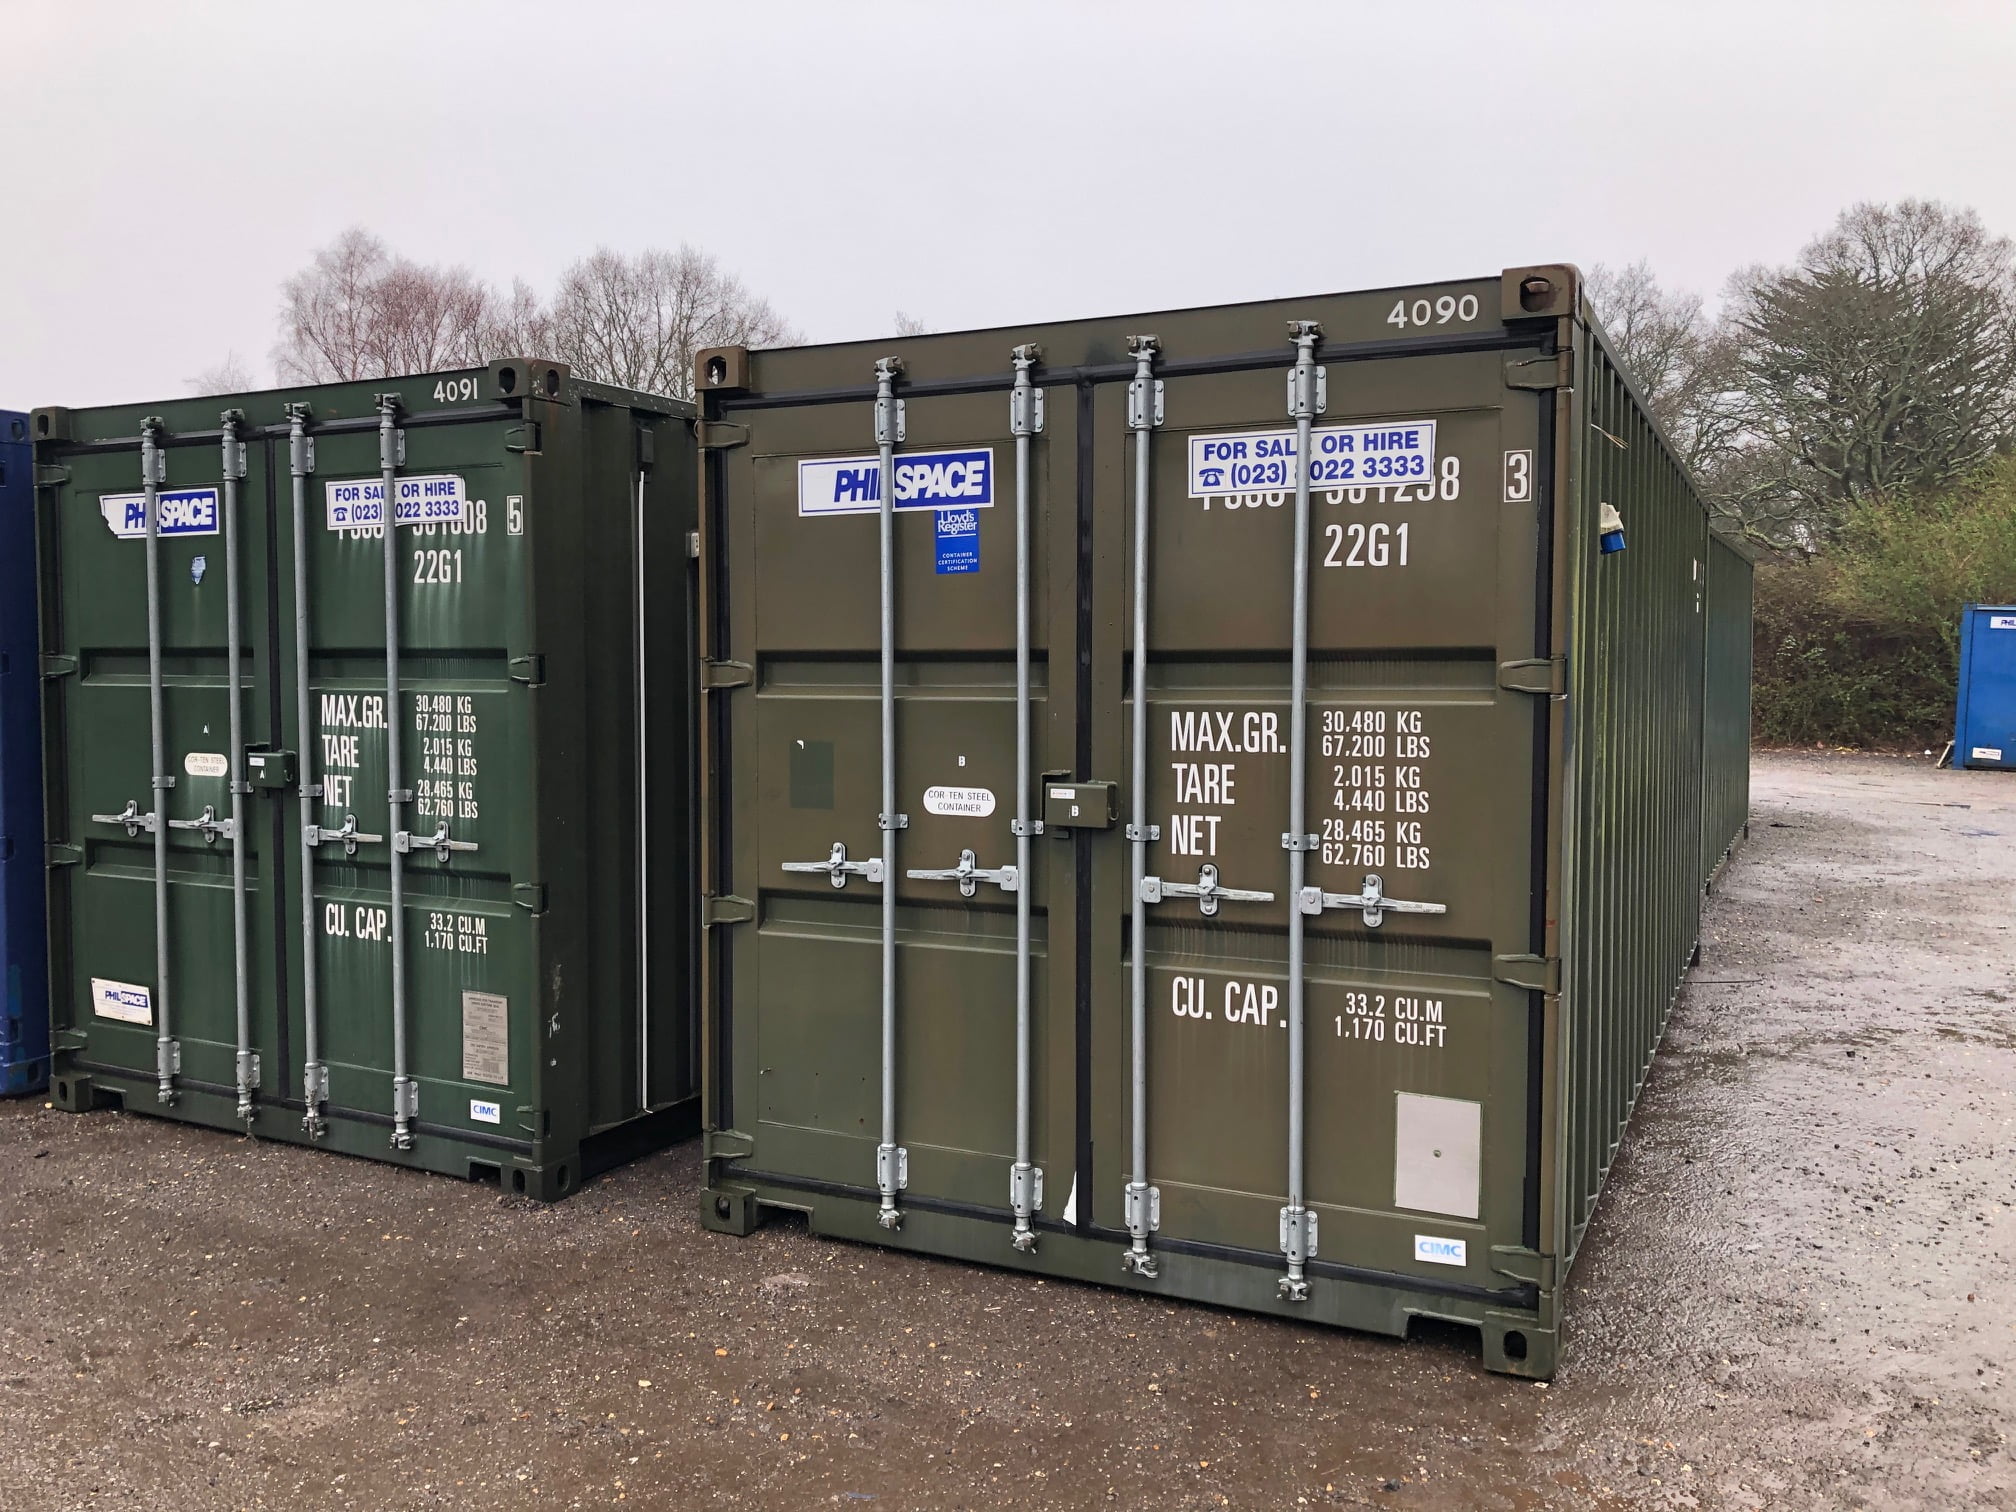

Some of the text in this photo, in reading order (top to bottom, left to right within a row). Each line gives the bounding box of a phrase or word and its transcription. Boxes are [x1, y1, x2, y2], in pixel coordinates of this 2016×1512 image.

[1387, 294, 1479, 329] 4090
[433, 377, 478, 403] 4091
[1204, 430, 1419, 461] FOR SAL OR HIRE
[1231, 455, 1424, 488] (023) 022 3333
[1507, 452, 1529, 500] 3
[335, 487, 360, 502] FOR
[401, 483, 420, 498] OR
[425, 481, 456, 496] HIRE
[351, 500, 459, 523] (023) 022 3333
[509, 498, 521, 533] 5
[938, 520, 977, 535] Register
[1324, 522, 1409, 568] 22G1
[413, 549, 462, 584] 22G1
[938, 558, 978, 566] CERTIFICATION
[321, 694, 388, 729] MAX.GR.
[416, 694, 472, 714] 30,480 KG
[203, 724, 209, 734] A
[416, 714, 477, 733] 67,200 LBS
[1171, 711, 1287, 753] MAX.GR.
[1323, 710, 1422, 733] 30,480 KG
[321, 734, 360, 768] TARE
[423, 737, 472, 757] 2,015 KG
[1322, 735, 1430, 759] 67,200 LBS
[424, 756, 478, 776] 4,440 LBS
[958, 755, 966, 767] B
[259, 769, 265, 780] A
[1171, 763, 1235, 805] TARE
[1333, 765, 1421, 789] 2,015 KG
[323, 774, 353, 807] NET
[417, 779, 473, 800] 28,465 KG
[967, 791, 991, 802] STEEL
[1333, 789, 1430, 814] 4,440 LBS
[418, 798, 479, 819] 62,760 LBS
[937, 801, 982, 813] CONTAINER
[1071, 805, 1080, 817] B
[1171, 814, 1222, 856] NET
[1322, 818, 1422, 845] 28,465 KG
[1322, 843, 1430, 870] 62,760 LBS
[325, 903, 393, 943] CU. CAP.
[430, 912, 486, 936] 33.2 CU.M
[424, 930, 488, 955] 1,170 CU.FT
[1172, 976, 1287, 1028] CU. CAP.
[1345, 992, 1443, 1024] 33.2 CU.M
[1335, 1015, 1447, 1048] 1,170 CU.FT
[473, 1104, 497, 1117] CIMC
[1418, 1241, 1463, 1258] CIMC
